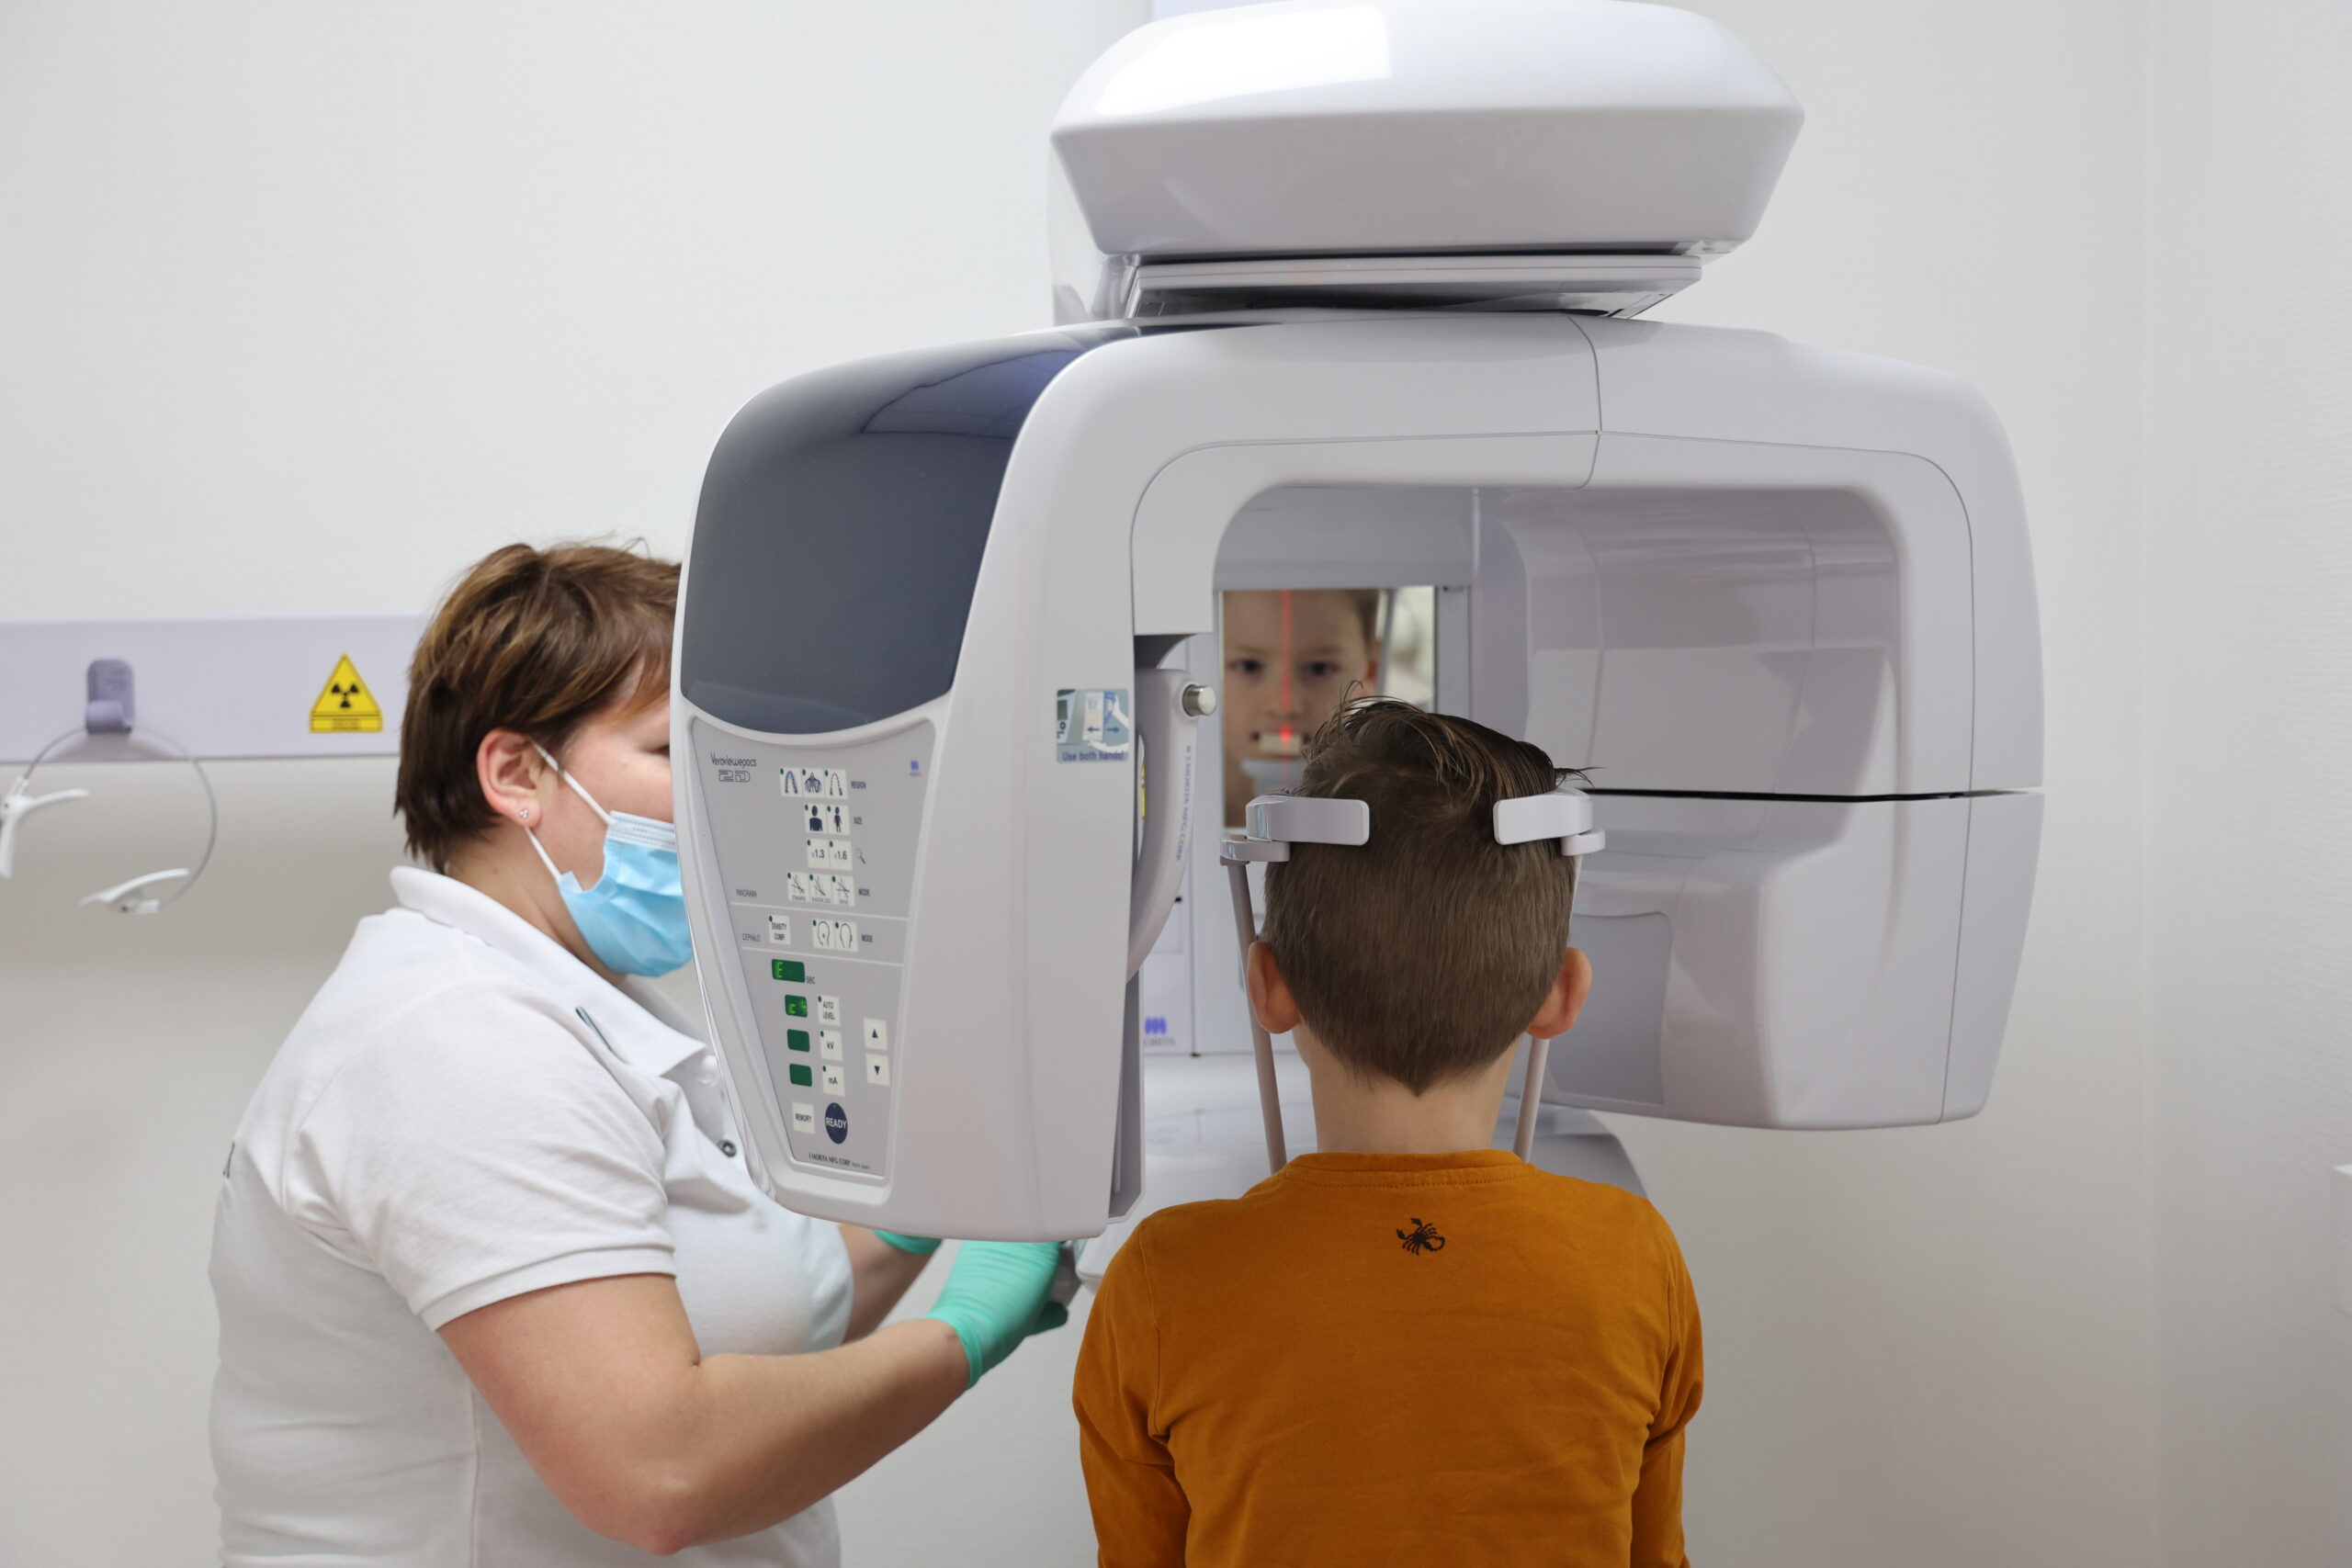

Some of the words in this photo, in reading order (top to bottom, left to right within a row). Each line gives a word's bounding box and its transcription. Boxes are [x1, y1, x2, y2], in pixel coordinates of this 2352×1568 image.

[718, 769, 751, 783] 2D
[827, 1041, 834, 1050] kV
[829, 1077, 838, 1085] mA
[796, 1112, 811, 1122] MEMORY
[825, 1117, 847, 1129] READY
